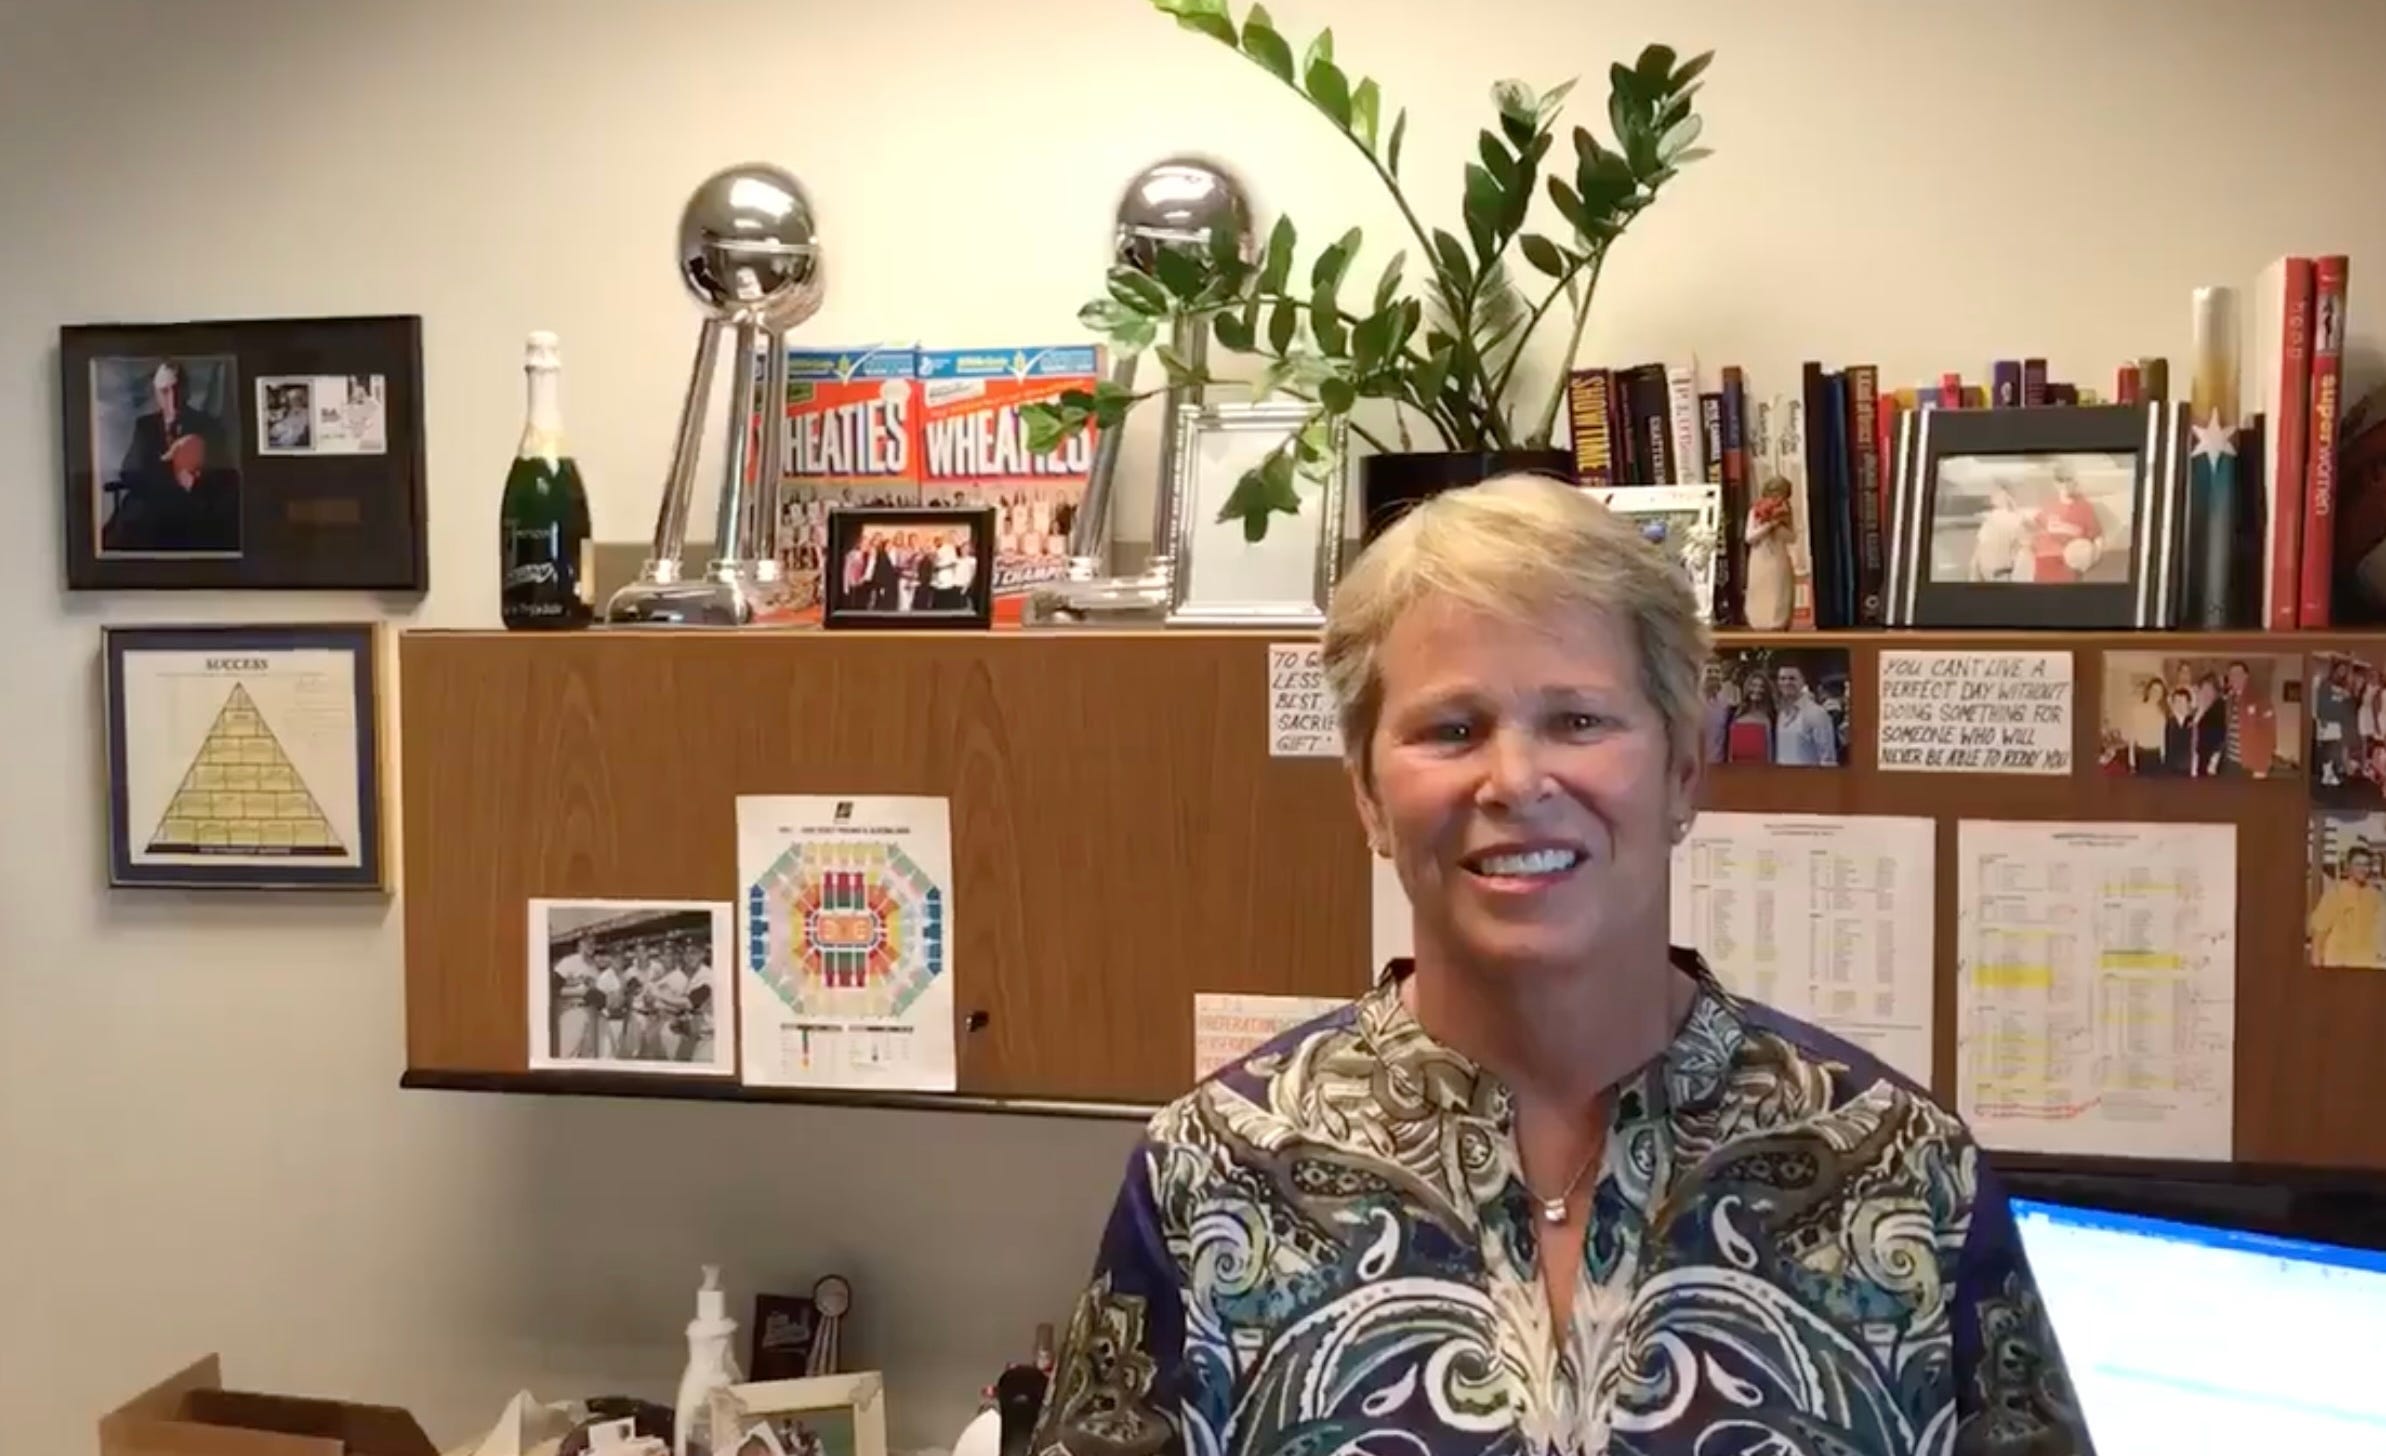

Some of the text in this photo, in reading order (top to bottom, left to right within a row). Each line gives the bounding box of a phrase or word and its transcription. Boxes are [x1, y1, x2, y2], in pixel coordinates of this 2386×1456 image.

[1571, 376, 1611, 473] SHOWTIME
[783, 396, 908, 476] HEATIES
[924, 397, 1090, 477] WHEATS
[2315, 373, 2336, 516] superwomen
[206, 657, 269, 671] SUCCESS
[1274, 651, 1298, 669] TO
[1883, 657, 1922, 675] YOU
[1984, 657, 2024, 678] LIVE
[2031, 658, 2047, 677] A
[1273, 672, 1321, 689] LESS
[1882, 680, 2069, 701] PERFECT DAY WITHOUT
[1883, 703, 2063, 723] DOING SOMETHING FOR
[1881, 726, 2036, 746] SOMEONE WHO WILL
[1881, 748, 1923, 764] NEVER
[1925, 749, 1942, 766] BE
[1944, 749, 1979, 767] ABLE
[1982, 749, 2000, 767] TO
[2042, 749, 2068, 769] YOU
